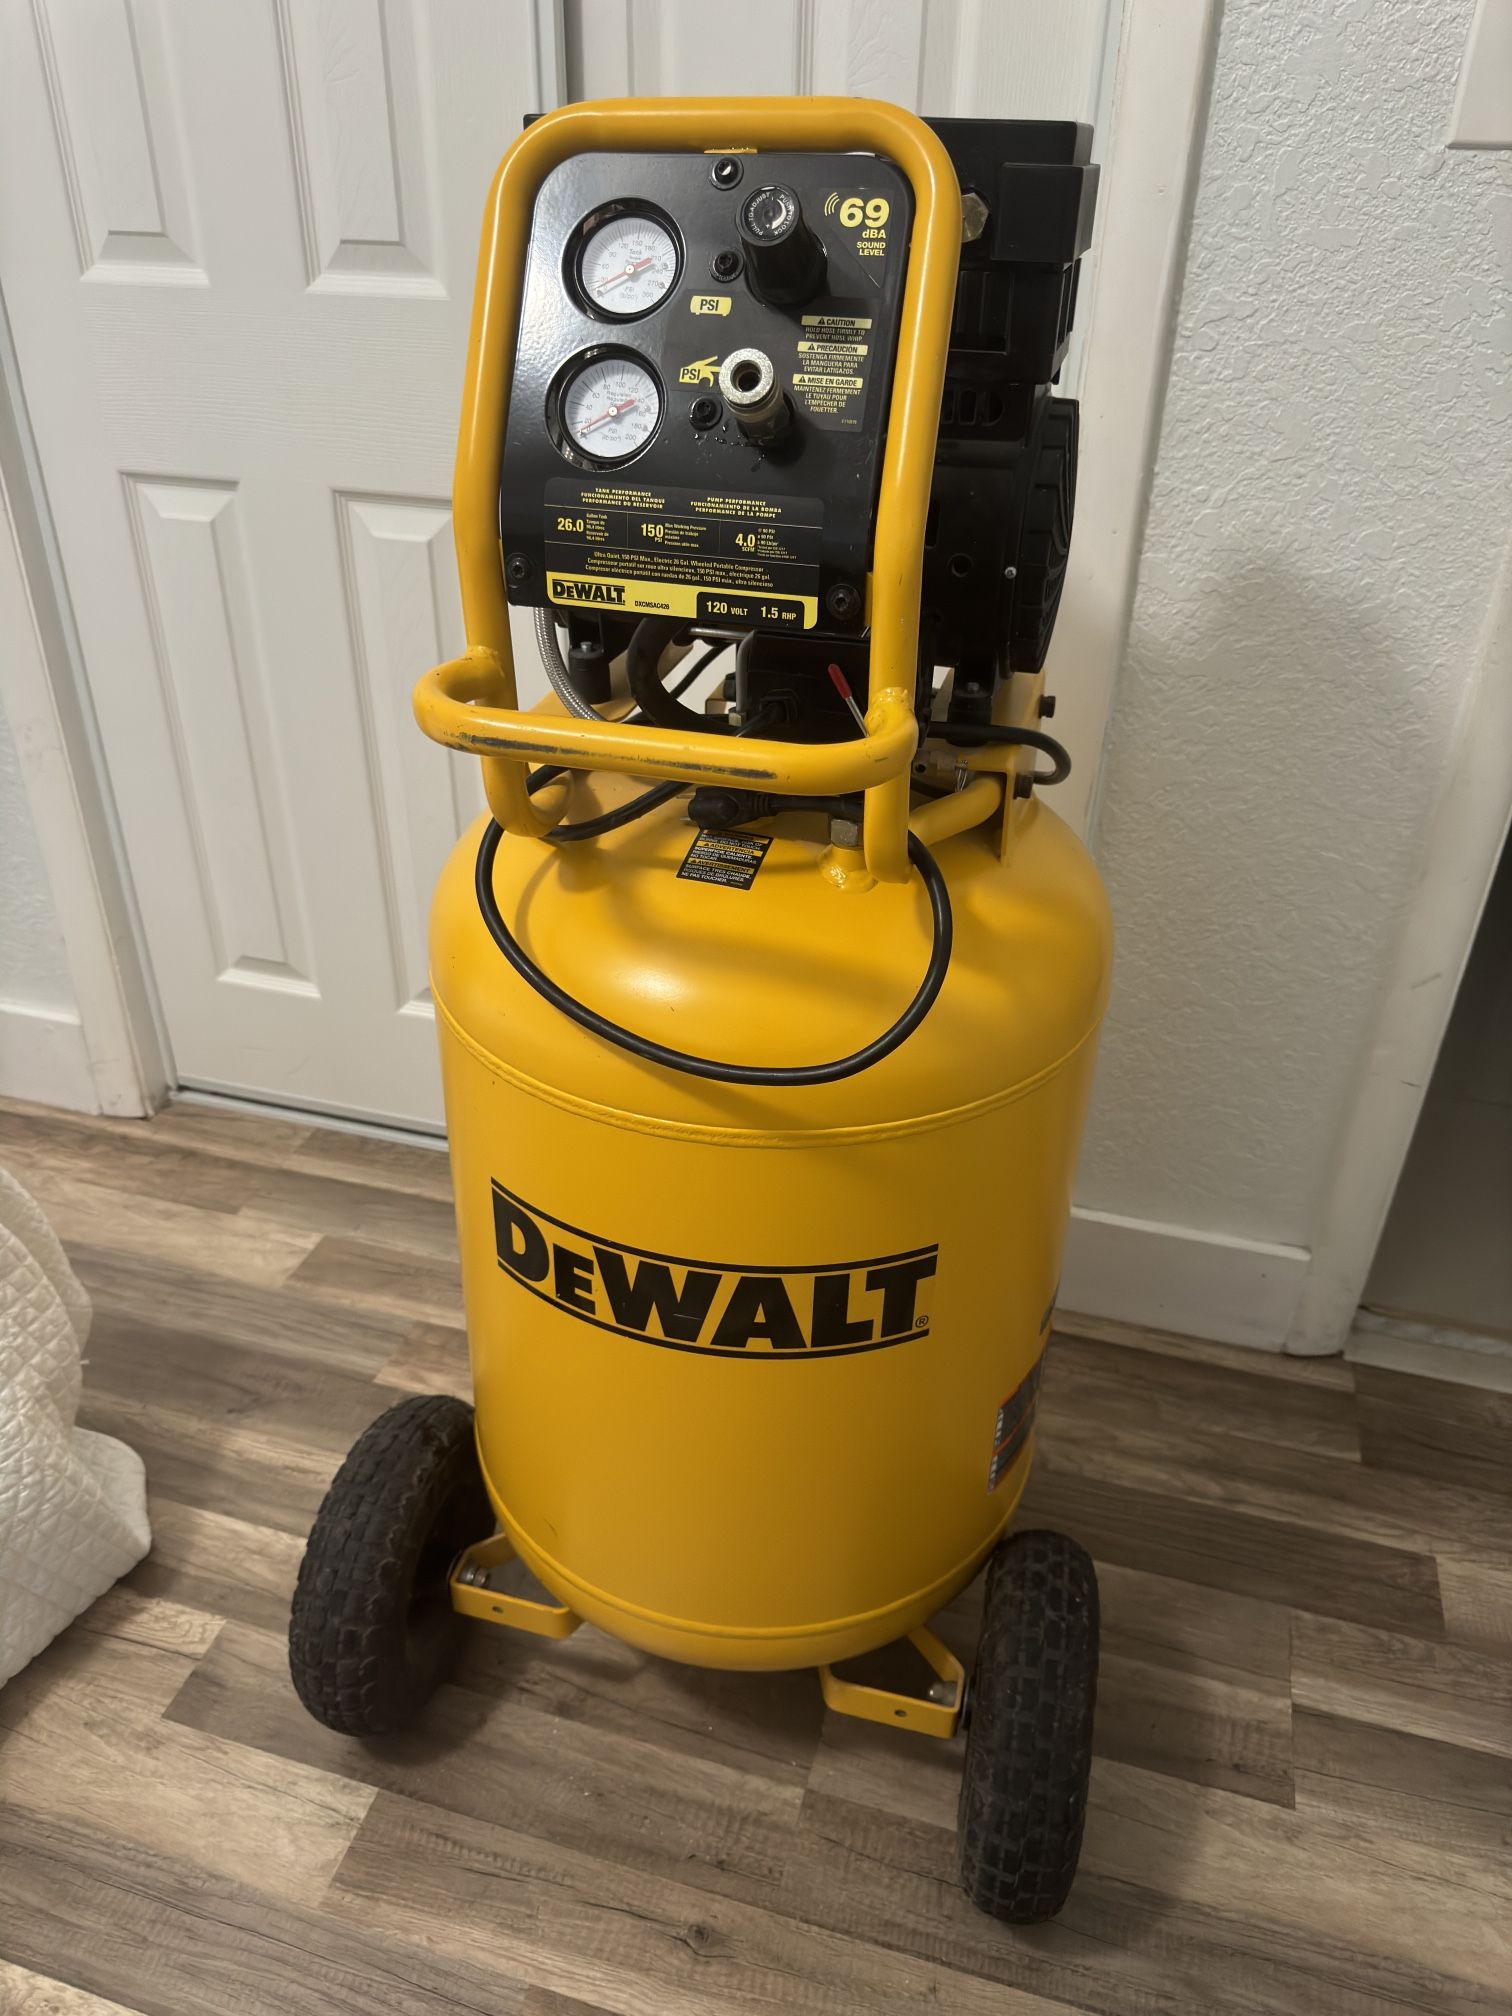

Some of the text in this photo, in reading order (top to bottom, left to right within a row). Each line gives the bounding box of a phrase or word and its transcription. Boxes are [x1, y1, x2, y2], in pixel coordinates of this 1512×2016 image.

[752, 192, 770, 211] ADJUST
[780, 194, 792, 210] PUSH
[839, 198, 890, 228] 69
[752, 223, 763, 236] PULL
[774, 220, 790, 236] LOCK
[862, 229, 886, 239] dBA
[700, 299, 719, 311] PSI
[826, 318, 856, 327] CAUTION
[811, 360, 842, 368] MANGUERA
[681, 368, 700, 380] PSI
[794, 385, 861, 395] MAINTENEZ FERMEMENT
[581, 492, 630, 501] FUNCIONAMIENTO
[611, 489, 652, 497] PERFORMANCE
[582, 498, 621, 506] PERFORMANCE
[690, 501, 741, 510] FUNCIONAMIENTO
[725, 498, 766, 506] PERFORMANCE
[695, 507, 736, 515] PERFORMANCE
[557, 517, 584, 532] 26.0
[641, 523, 664, 538] 150
[735, 533, 756, 547] 4.0
[690, 560, 713, 568] Wheeled
[713, 562, 734, 570] Portable
[735, 564, 764, 573] Compressor
[585, 564, 610, 573] Compresor
[748, 580, 774, 588] silencioso
[553, 580, 625, 604] DEWALT
[706, 601, 797, 620] 120 VOLT 1.5 RHP
[694, 846, 753, 860] SUPERFICIE CALIENTE.
[710, 843, 755, 855] ADVERTENCIA
[697, 860, 751, 873] AVERTISSEMENT
[491, 1186, 938, 1349] DEWALT
